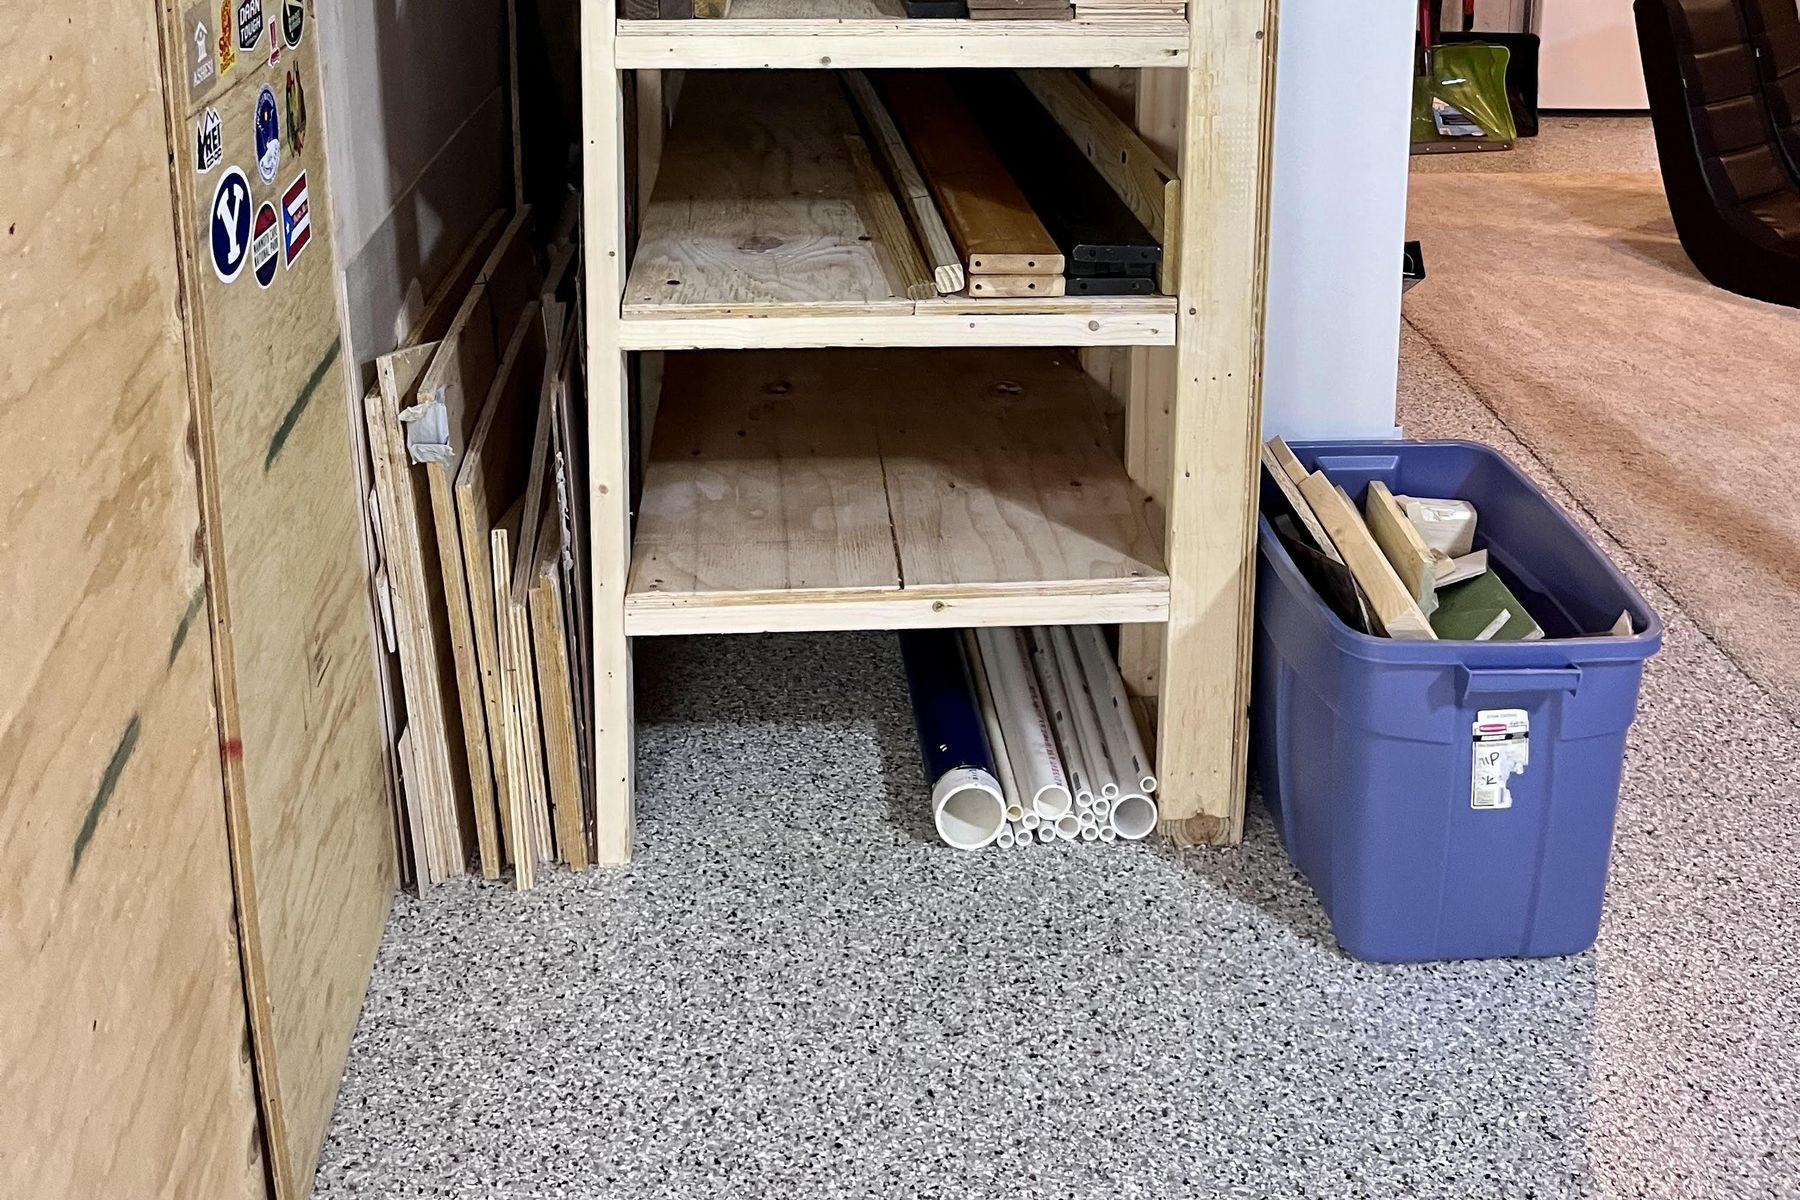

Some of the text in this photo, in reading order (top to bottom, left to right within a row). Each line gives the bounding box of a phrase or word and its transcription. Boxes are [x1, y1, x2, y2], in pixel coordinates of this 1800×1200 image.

[240, 15, 262, 44] TOUGH
[206, 123, 222, 158] REI
[217, 185, 244, 265] Y
